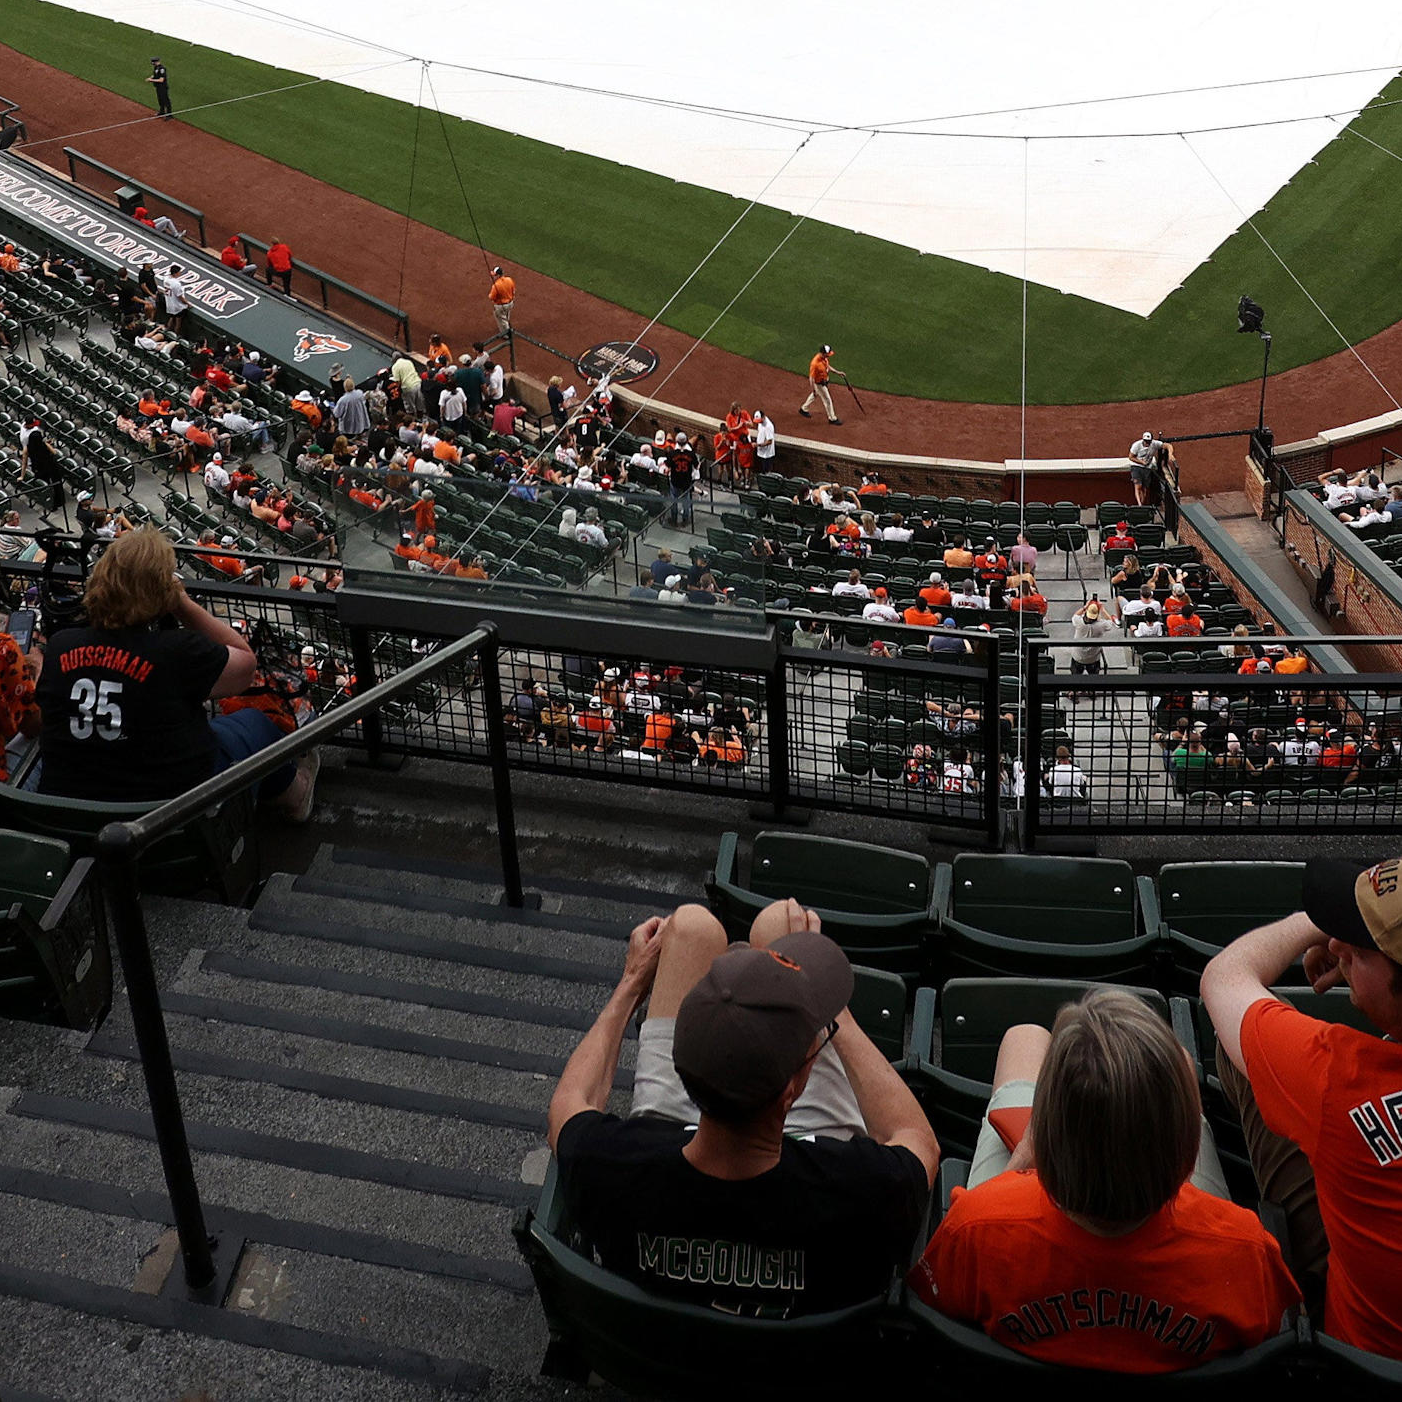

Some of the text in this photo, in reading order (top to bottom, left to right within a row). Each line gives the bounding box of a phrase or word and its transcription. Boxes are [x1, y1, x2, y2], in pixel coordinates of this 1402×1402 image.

[64, 217, 107, 239] TO
[59, 645, 154, 683] RUTSCHMAN
[70, 678, 123, 741] 35
[637, 1232, 805, 1290] MCGOUGH
[999, 1288, 1220, 1355] RUTSCHMAN
